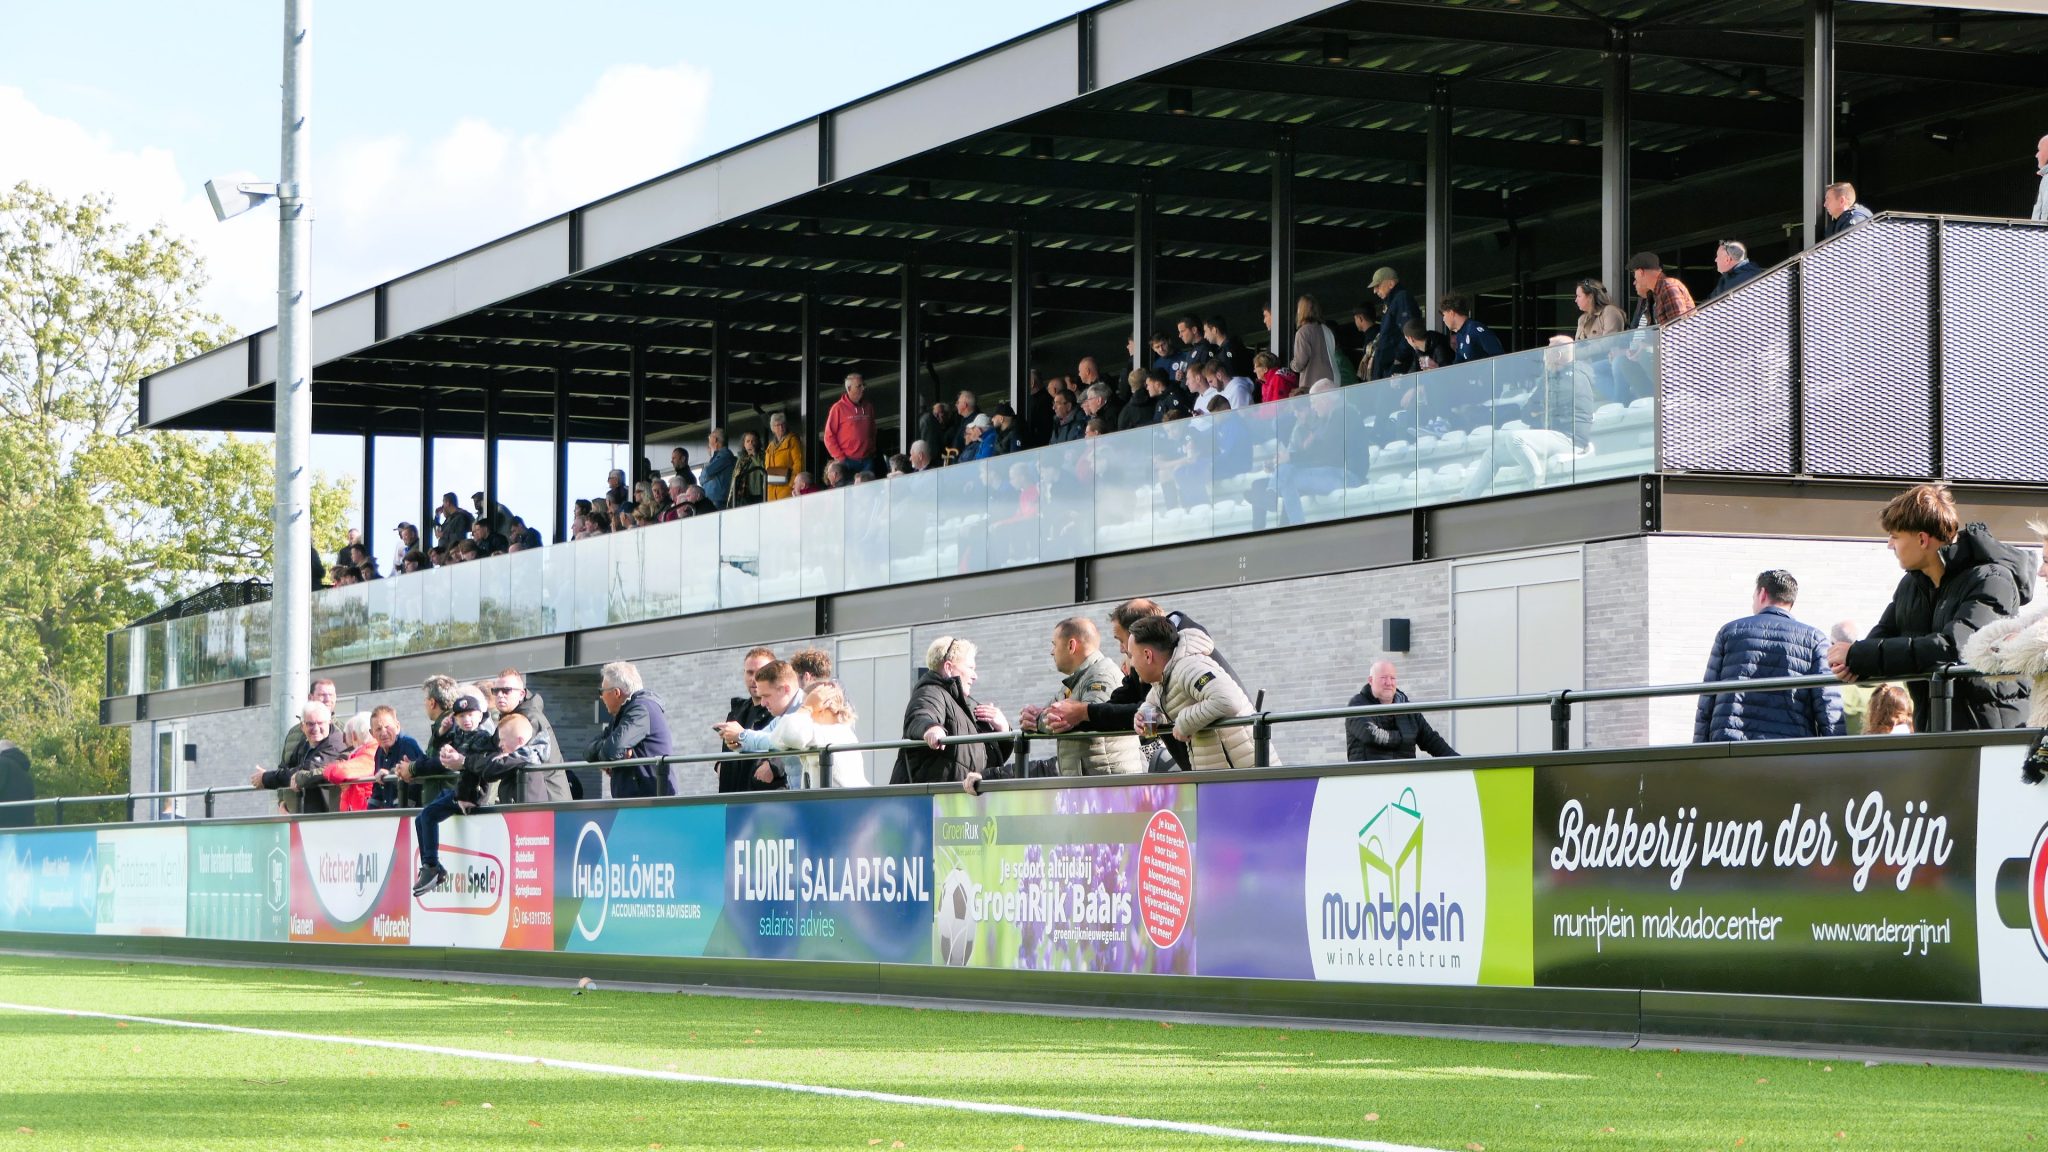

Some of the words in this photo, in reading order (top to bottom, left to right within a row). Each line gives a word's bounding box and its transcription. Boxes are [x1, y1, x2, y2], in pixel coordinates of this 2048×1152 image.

[1550, 799, 1698, 891] Bakkerij
[1702, 819, 1769, 867] van
[1773, 803, 1838, 867] der
[1845, 790, 1954, 892] Grijn
[320, 852, 378, 894] Kitchen4All
[454, 871, 467, 894] en
[467, 864, 489, 899] Spel
[577, 864, 604, 898] HLB
[611, 854, 675, 899] BLÖMER
[734, 838, 795, 902] FLORIE
[801, 856, 929, 902] SALARIS.NL
[1000, 858, 1011, 884] Je
[1013, 860, 1046, 880] scoort
[1048, 856, 1076, 884] altijd
[1078, 855, 1093, 884] bij
[611, 904, 655, 918] ACCOUNTANTS
[656, 905, 665, 918] EN
[666, 905, 701, 919] ADVISEURS
[759, 909, 794, 936] salaris
[800, 910, 835, 938] advies
[970, 882, 1067, 934] GroenRijk
[1072, 884, 1132, 925] Baars
[1322, 891, 1464, 951] Muntplein
[290, 914, 313, 935] Vianen
[373, 914, 410, 942] Mijdrecht
[1053, 926, 1127, 944] groenrijknieuwegein.nl
[1553, 905, 1635, 953] muntplein
[1642, 906, 1783, 941] makadocenter
[1811, 917, 1951, 956] www.vandergrijn.nl
[1326, 947, 1461, 969] winkelcentrum
